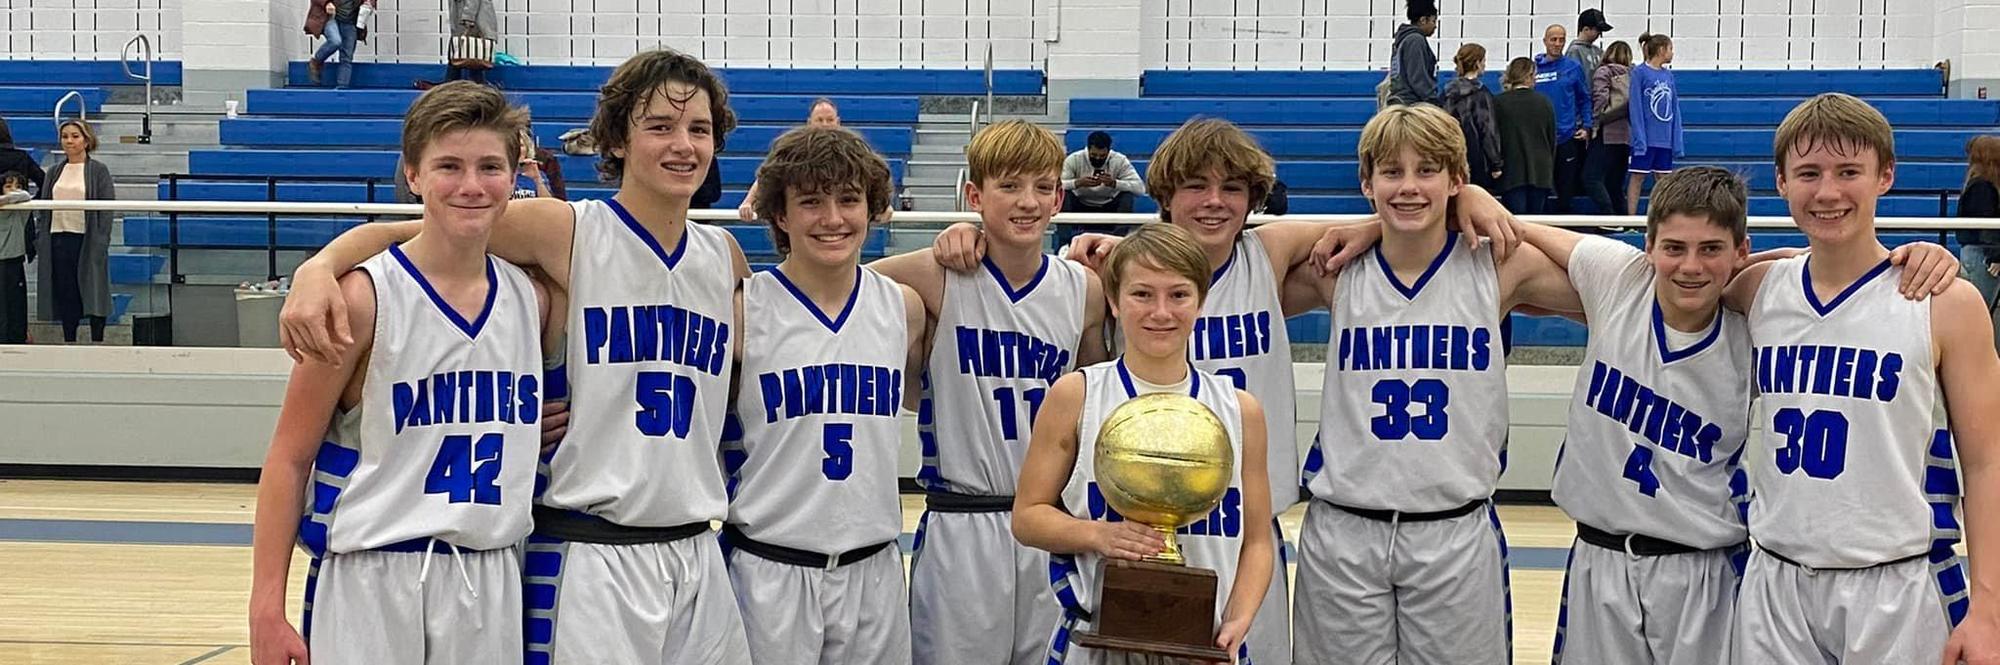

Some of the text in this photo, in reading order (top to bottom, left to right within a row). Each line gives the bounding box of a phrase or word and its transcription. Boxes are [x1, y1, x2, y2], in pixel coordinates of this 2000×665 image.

[583, 304, 729, 377] PANTHERS
[1193, 309, 1271, 361] THERS
[1338, 324, 1491, 371] PANTHERS
[758, 363, 901, 424] PANTHERS
[1751, 344, 1904, 403] ANTHERS
[634, 371, 697, 440] 50
[1370, 378, 1449, 441] 33
[1586, 359, 1723, 465] PANTHERS
[423, 432, 504, 506] 42
[822, 422, 853, 481] 5
[1622, 442, 1661, 499] 4
[1773, 407, 1849, 480] 30
